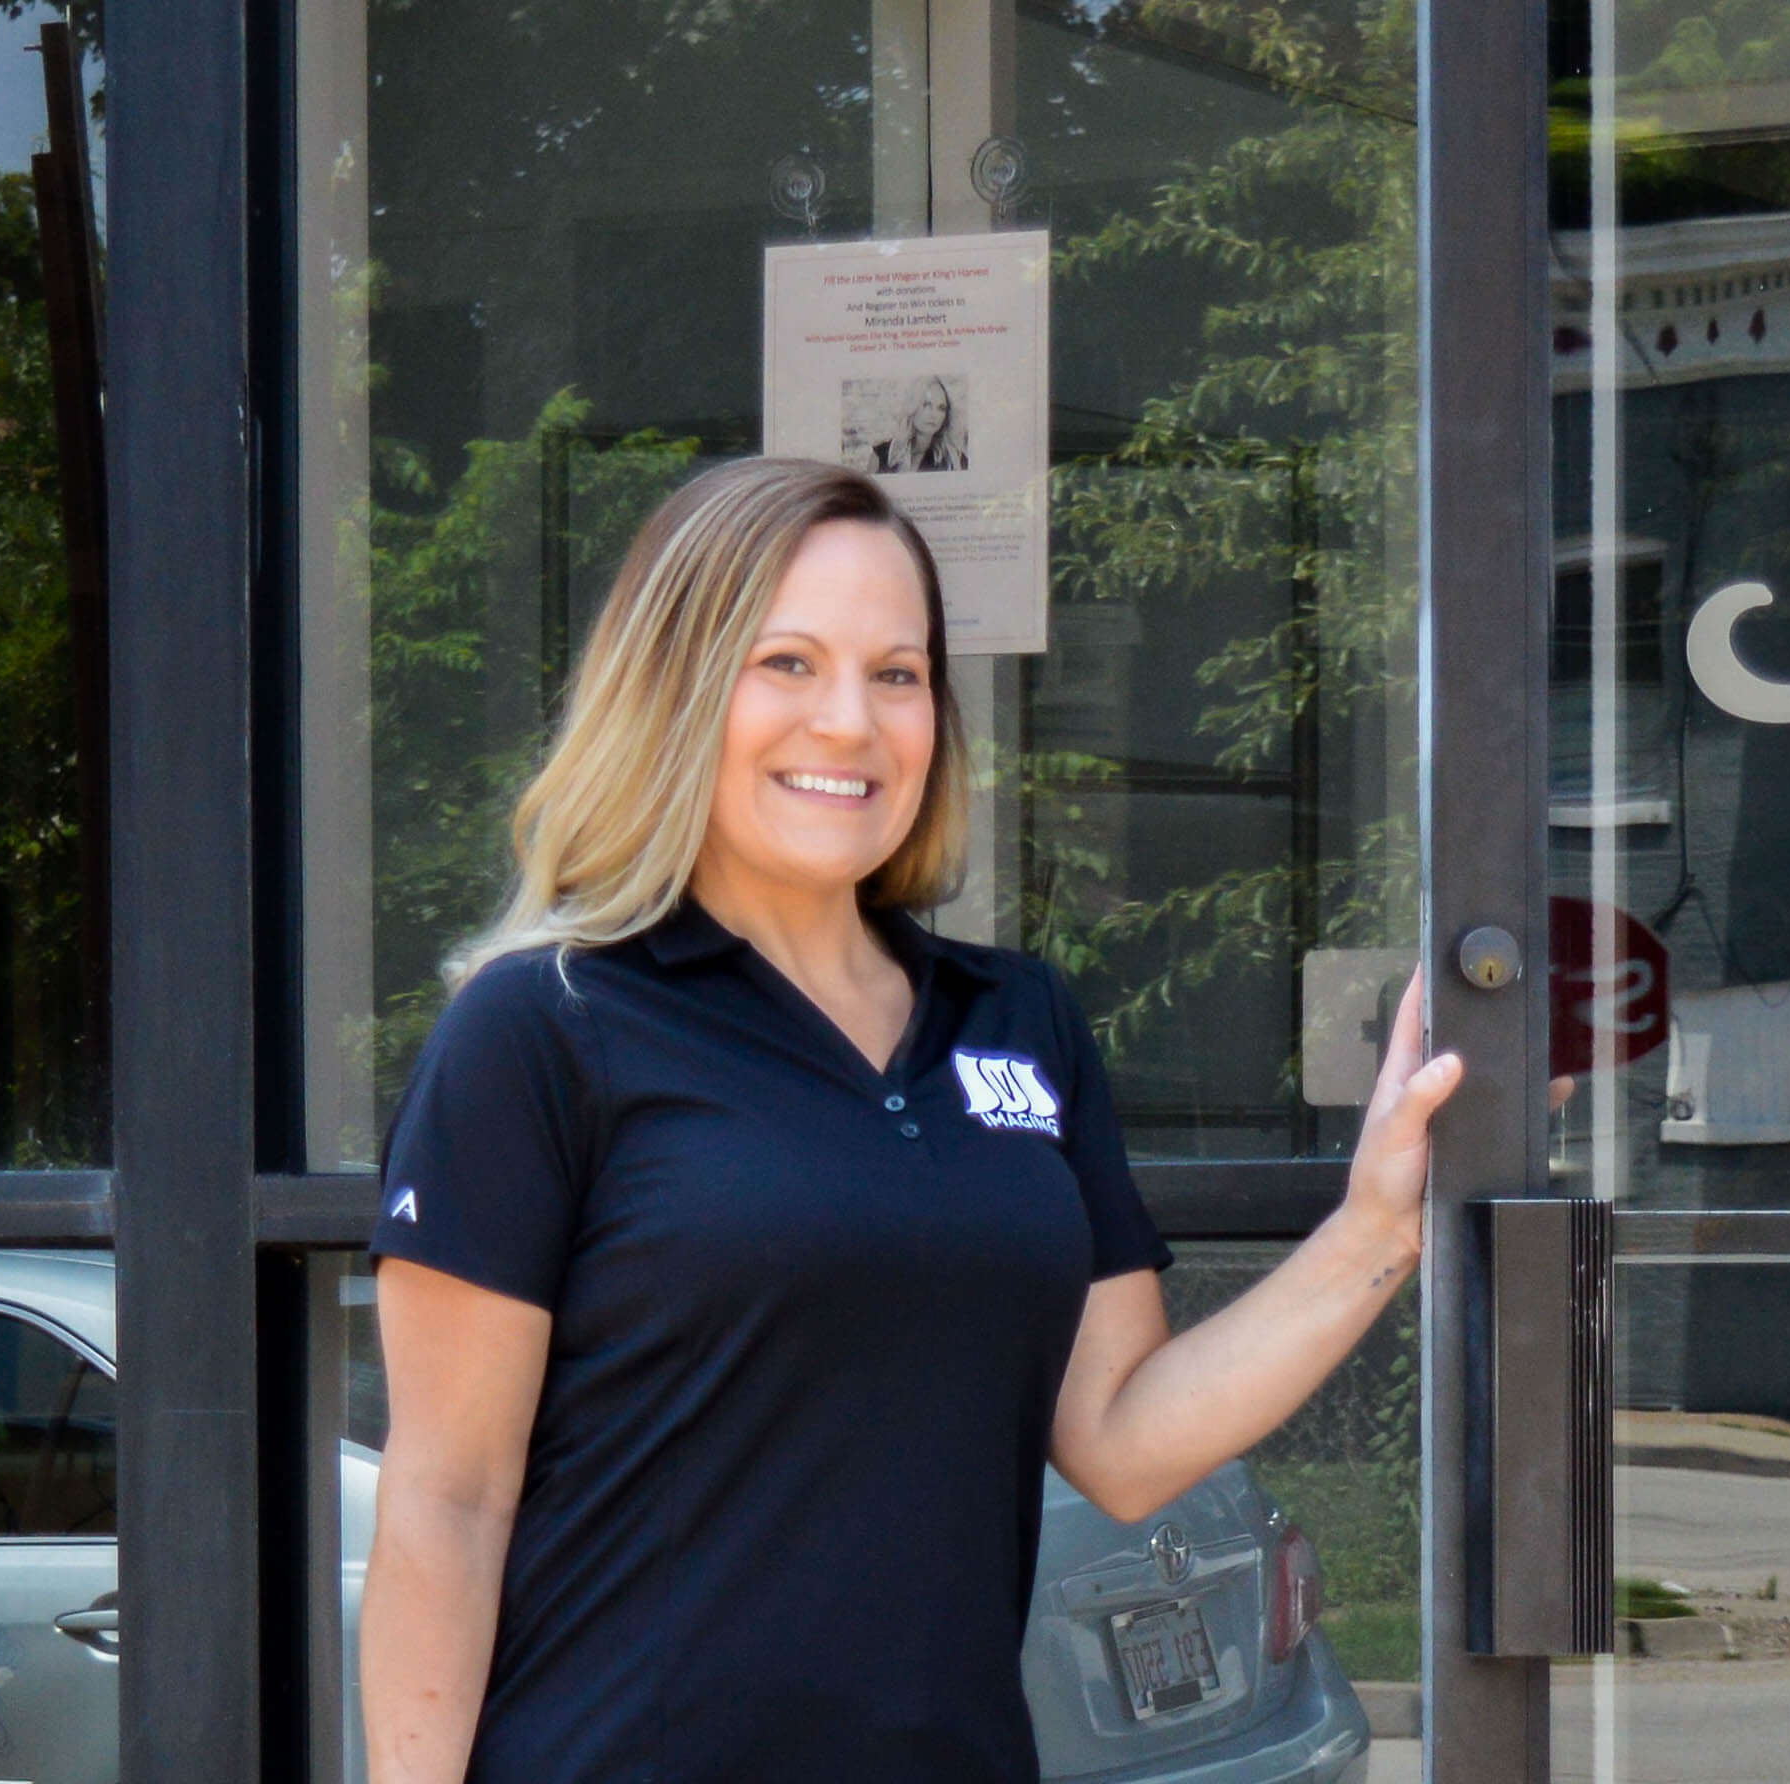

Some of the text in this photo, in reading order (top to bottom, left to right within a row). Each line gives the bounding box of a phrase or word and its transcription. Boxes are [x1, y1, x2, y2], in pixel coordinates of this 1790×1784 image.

[865, 313, 947, 328] Miranda Lambert
[980, 1111, 1060, 1138] IMAGING
